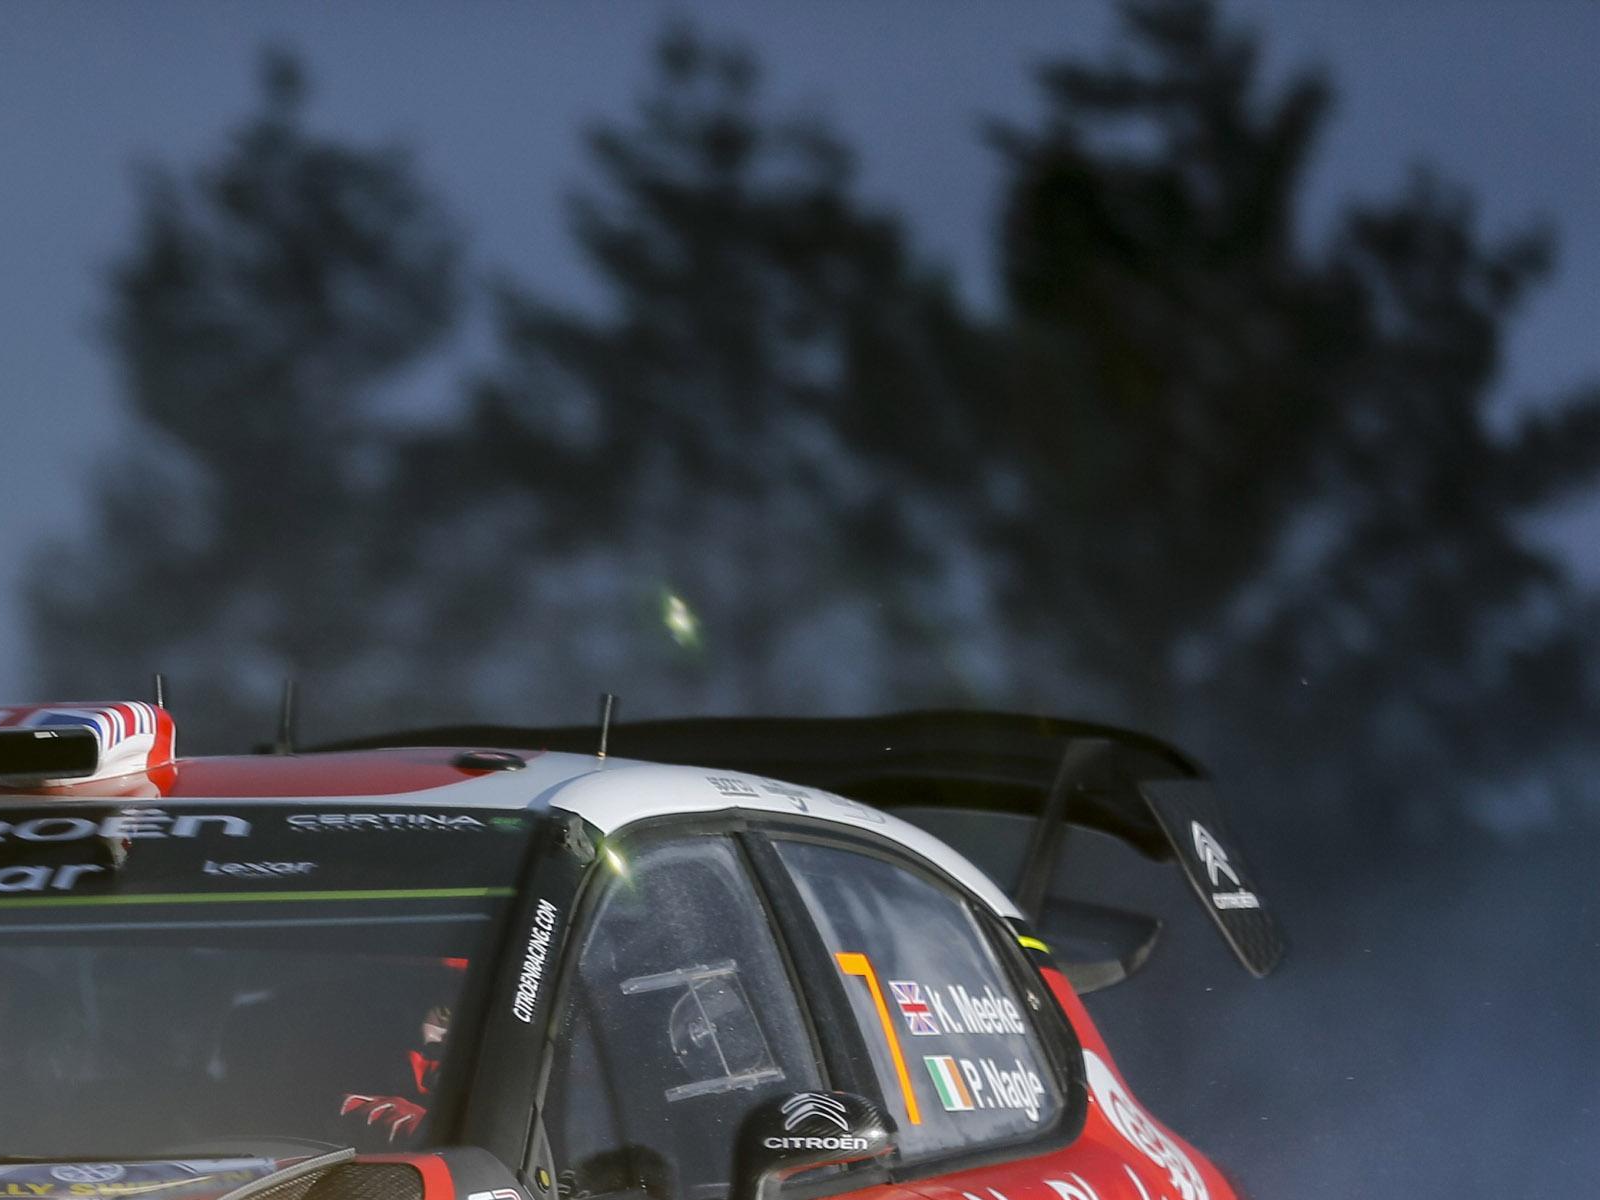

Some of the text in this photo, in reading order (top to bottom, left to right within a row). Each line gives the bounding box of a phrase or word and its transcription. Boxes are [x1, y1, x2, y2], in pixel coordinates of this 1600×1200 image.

[286, 813, 487, 827] CERTINA
[513, 898, 557, 1022] CITROENRACING.COM
[947, 983, 1026, 1034] Meeke
[834, 952, 922, 1125] 7
[959, 1057, 1046, 1123] P. Nagle
[763, 1134, 868, 1150] CITROËN
